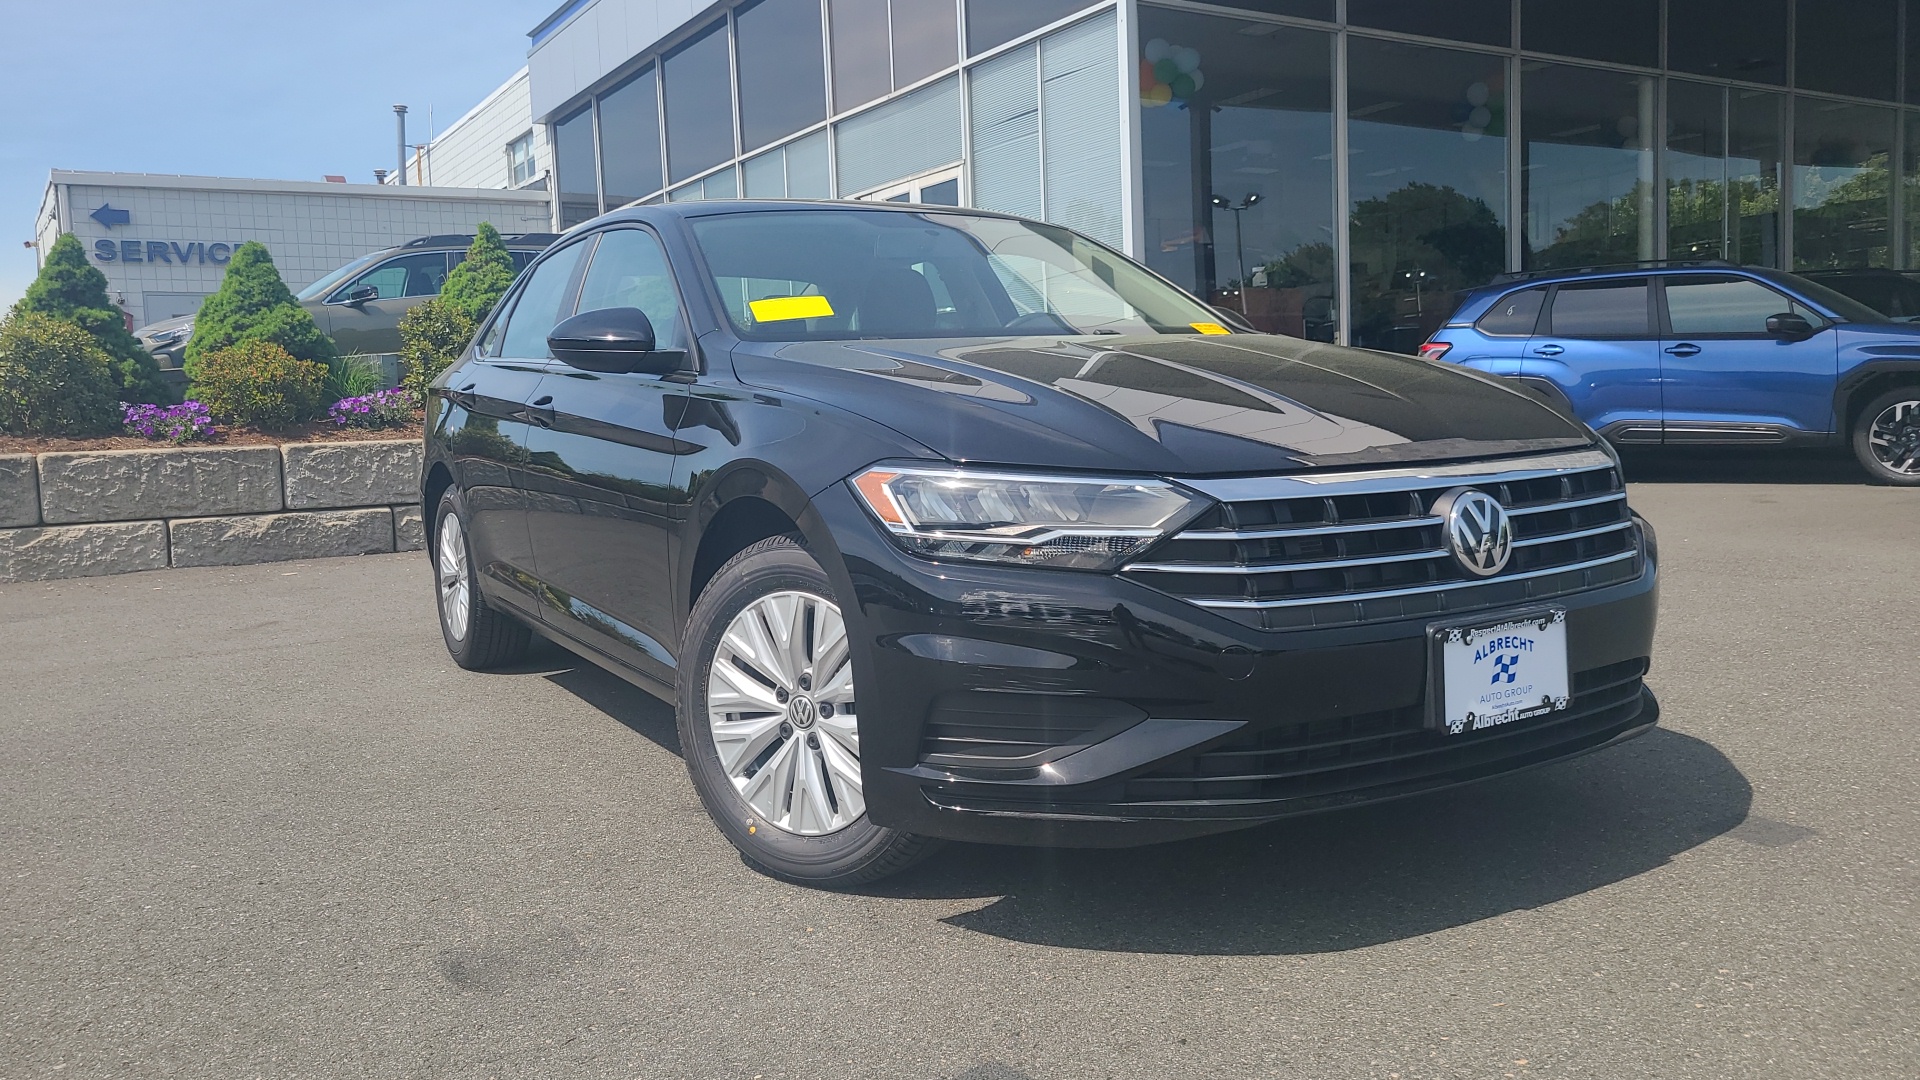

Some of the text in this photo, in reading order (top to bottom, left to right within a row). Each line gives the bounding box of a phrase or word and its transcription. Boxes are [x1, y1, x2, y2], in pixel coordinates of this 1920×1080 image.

[1473, 636, 1534, 664] ALBRECHT
[1479, 684, 1533, 704] AUTO GROUP
[1472, 707, 1551, 730] Albrecht AUTO GROUP
